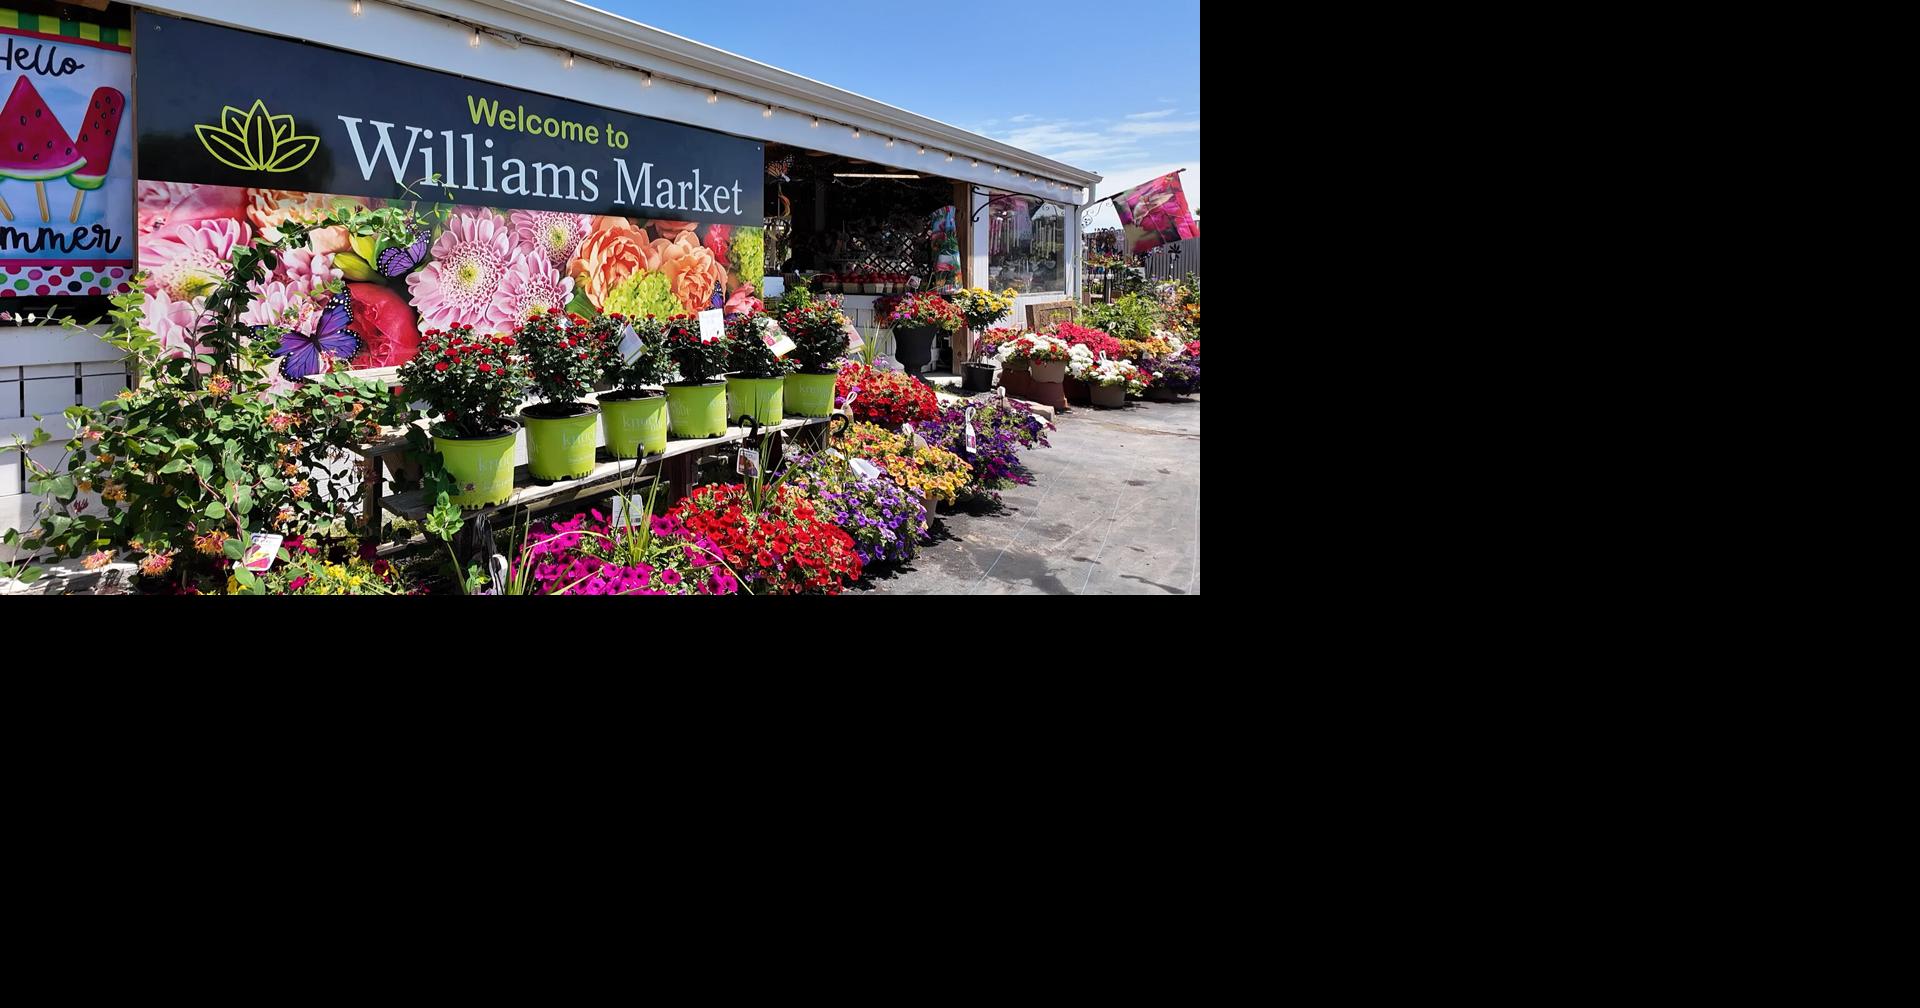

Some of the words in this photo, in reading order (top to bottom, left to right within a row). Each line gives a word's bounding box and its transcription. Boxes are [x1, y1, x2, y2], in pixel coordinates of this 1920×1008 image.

[467, 95, 599, 145] Welcome
[606, 124, 629, 149] to
[337, 115, 599, 202] Williams
[612, 158, 743, 215] Market
[0, 223, 122, 254] mmer
